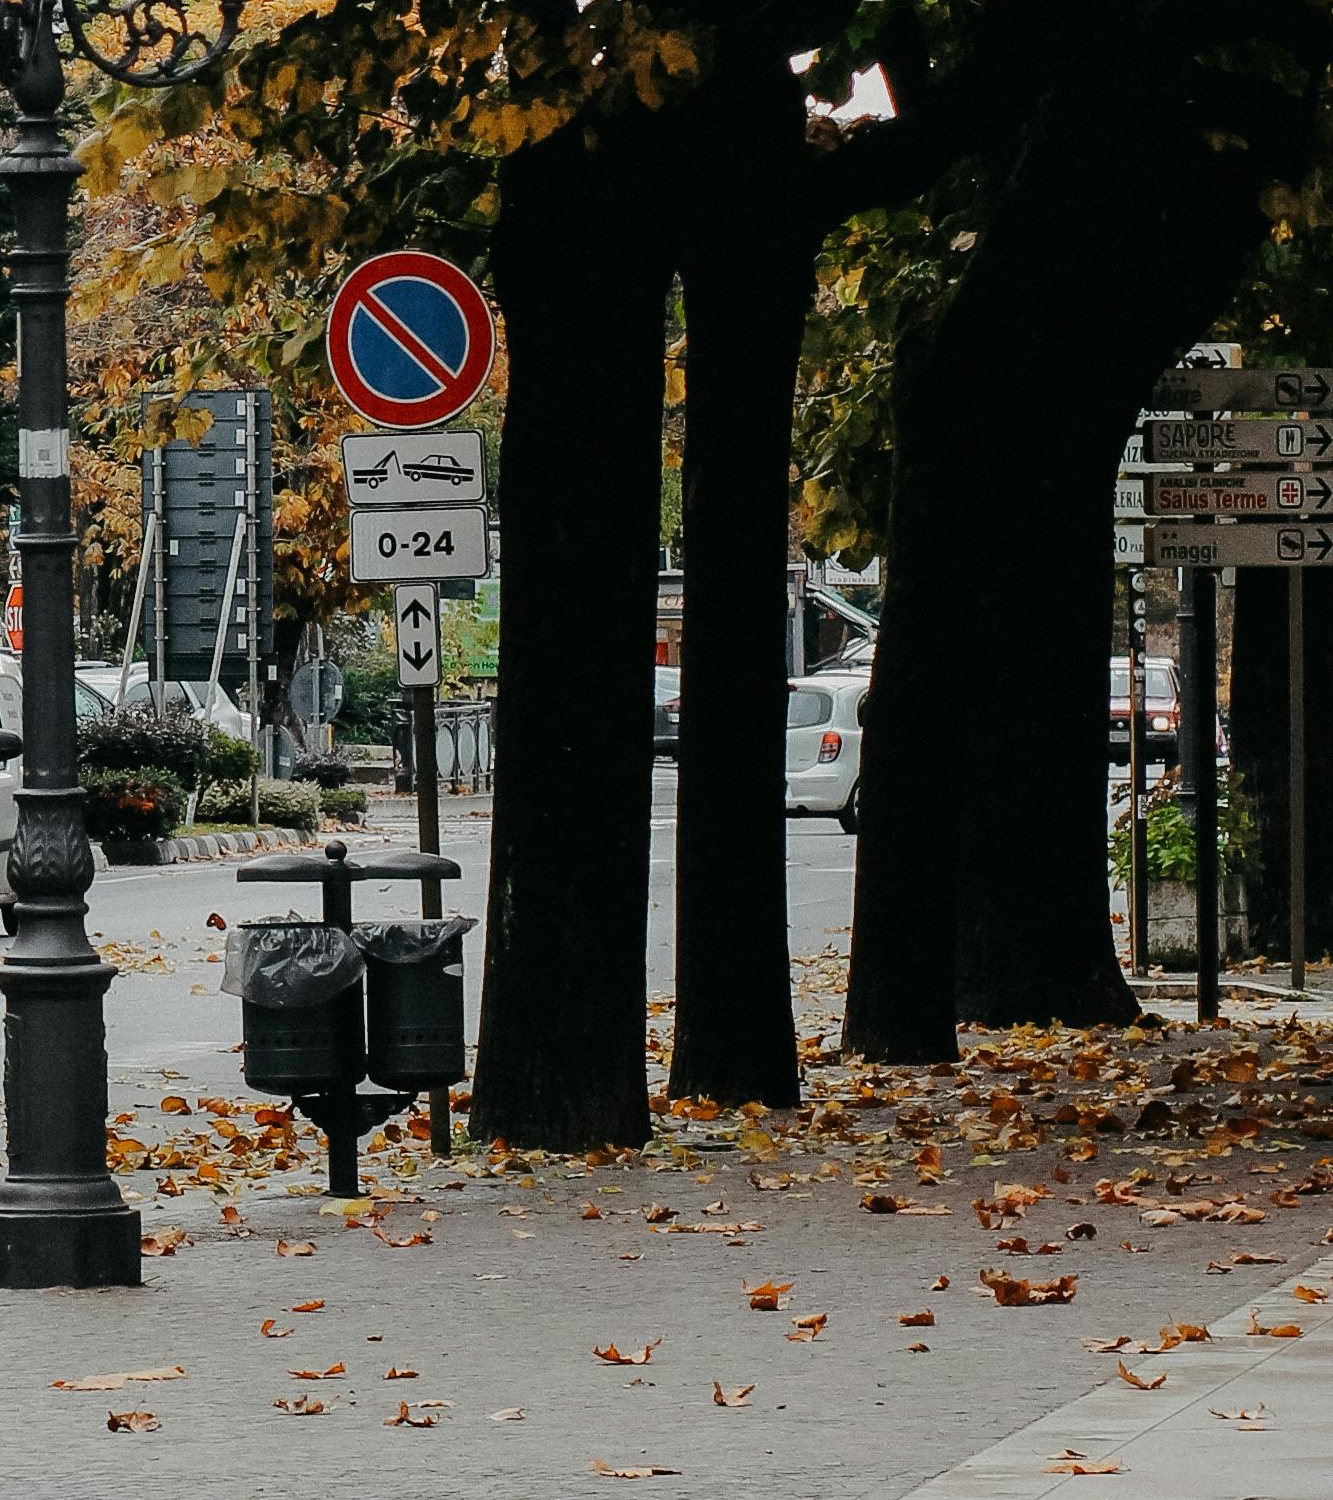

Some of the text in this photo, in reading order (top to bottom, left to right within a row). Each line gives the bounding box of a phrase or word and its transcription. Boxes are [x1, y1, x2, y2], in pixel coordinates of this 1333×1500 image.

[1158, 422, 1237, 450] SAPORE
[1159, 489, 1268, 510] Salus Terme
[378, 530, 455, 559] 0-24
[1159, 542, 1219, 564] maggi
[7, 606, 23, 633] ST
